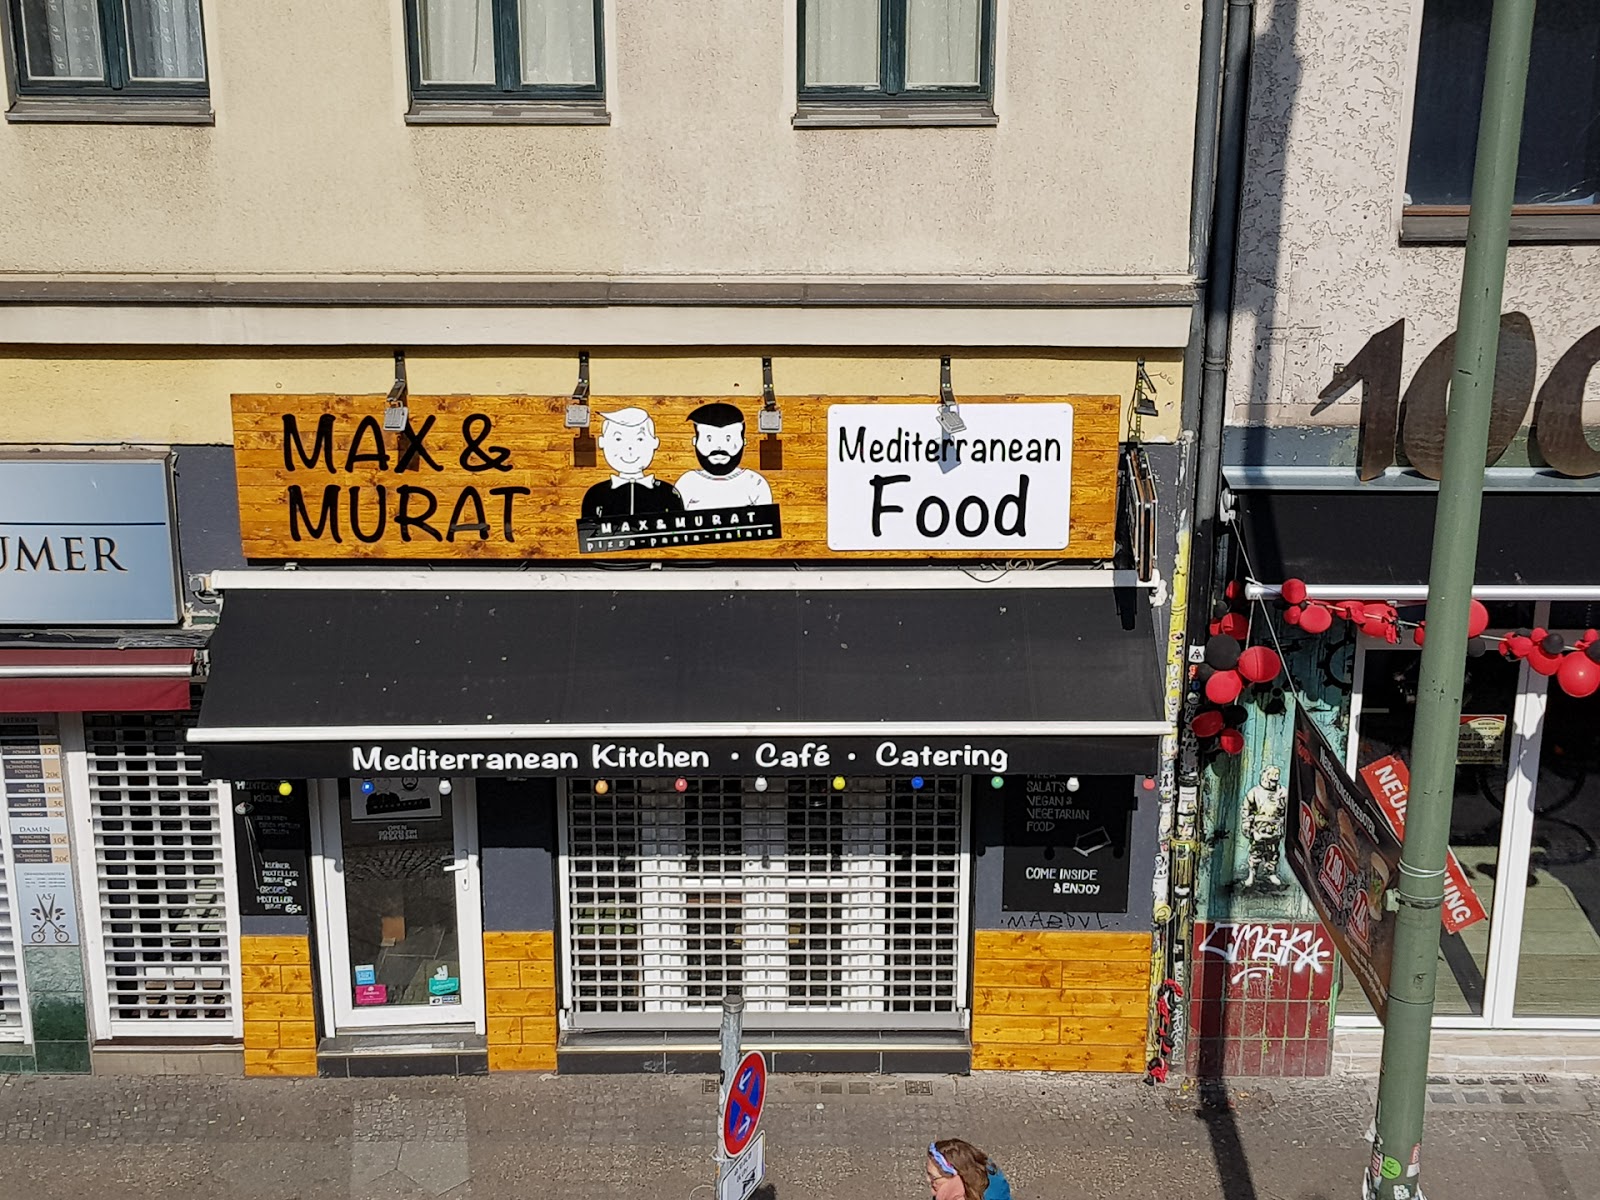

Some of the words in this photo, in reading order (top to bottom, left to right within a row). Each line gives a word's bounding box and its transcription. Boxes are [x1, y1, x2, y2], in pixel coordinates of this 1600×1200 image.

[282, 413, 444, 474] MAX
[459, 413, 514, 473] &
[838, 426, 1062, 464] Mediterranean
[287, 484, 531, 544] MURAT
[869, 473, 1030, 538] Food
[351, 746, 579, 771] Mediterranean
[591, 743, 710, 768] Kitchen
[754, 742, 831, 768] Café
[875, 741, 1009, 773] Catering
[1026, 795, 1064, 807] VEGAN
[1026, 807, 1090, 821] VEGETARIAN
[1026, 821, 1056, 833] FOOD
[1025, 866, 1057, 879] COME
[1059, 867, 1098, 881] INSIDE
